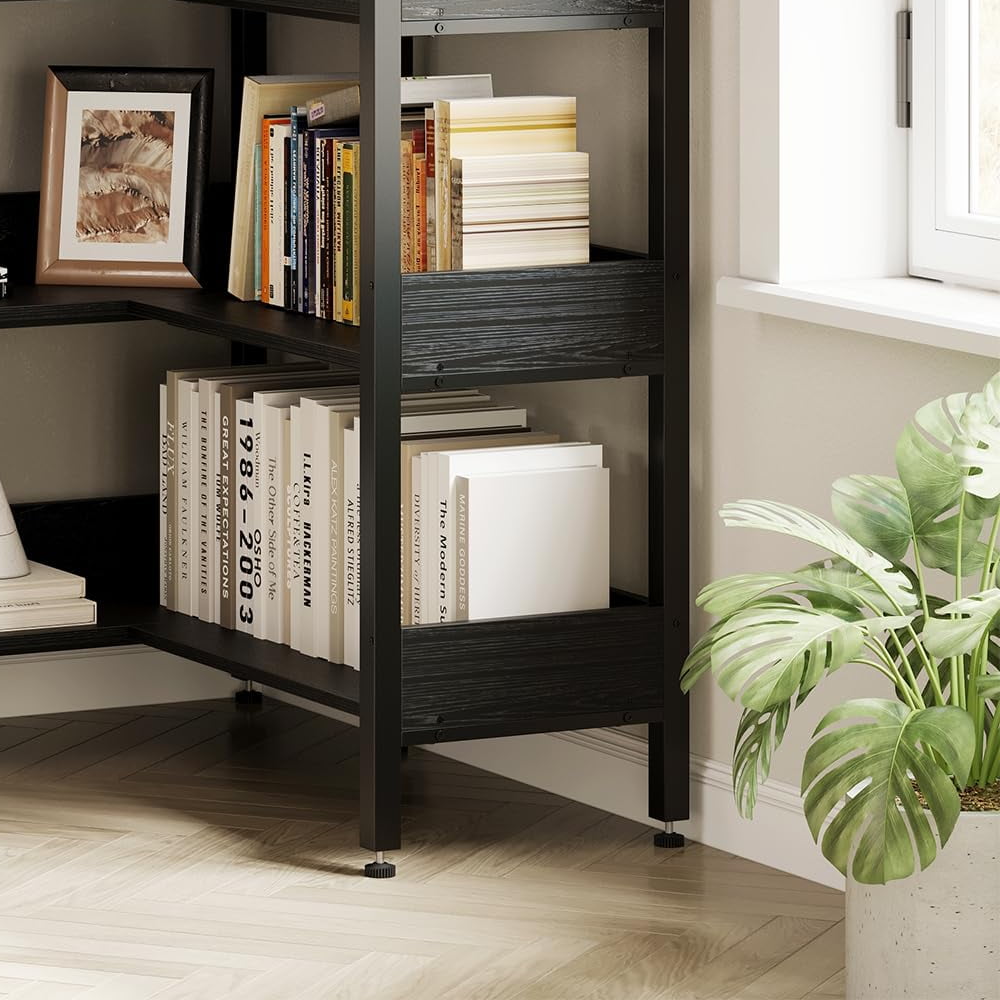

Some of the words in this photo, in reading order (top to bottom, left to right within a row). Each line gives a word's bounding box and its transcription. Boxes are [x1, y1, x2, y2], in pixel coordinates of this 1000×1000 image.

[167, 420, 175, 475] FLUX
[268, 456, 277, 482] The
[330, 459, 338, 495] ALEX
[200, 494, 207, 507] OF
[268, 486, 277, 526] Other
[330, 499, 338, 535] KATZ
[440, 500, 448, 530] The
[458, 494, 466, 545] MARINE
[346, 499, 354, 544] ALFRED
[253, 528, 262, 588] OSHO
[268, 530, 277, 559] Side
[268, 562, 277, 577] of
[303, 522, 311, 608] HACKERMAN
[330, 538, 338, 614] PAINTINGS
[346, 548, 354, 606] STIEGLITZ
[414, 570, 420, 582] of
[440, 536, 448, 600] Modern
[458, 549, 466, 610] GODDESS
[268, 580, 277, 601] Me
